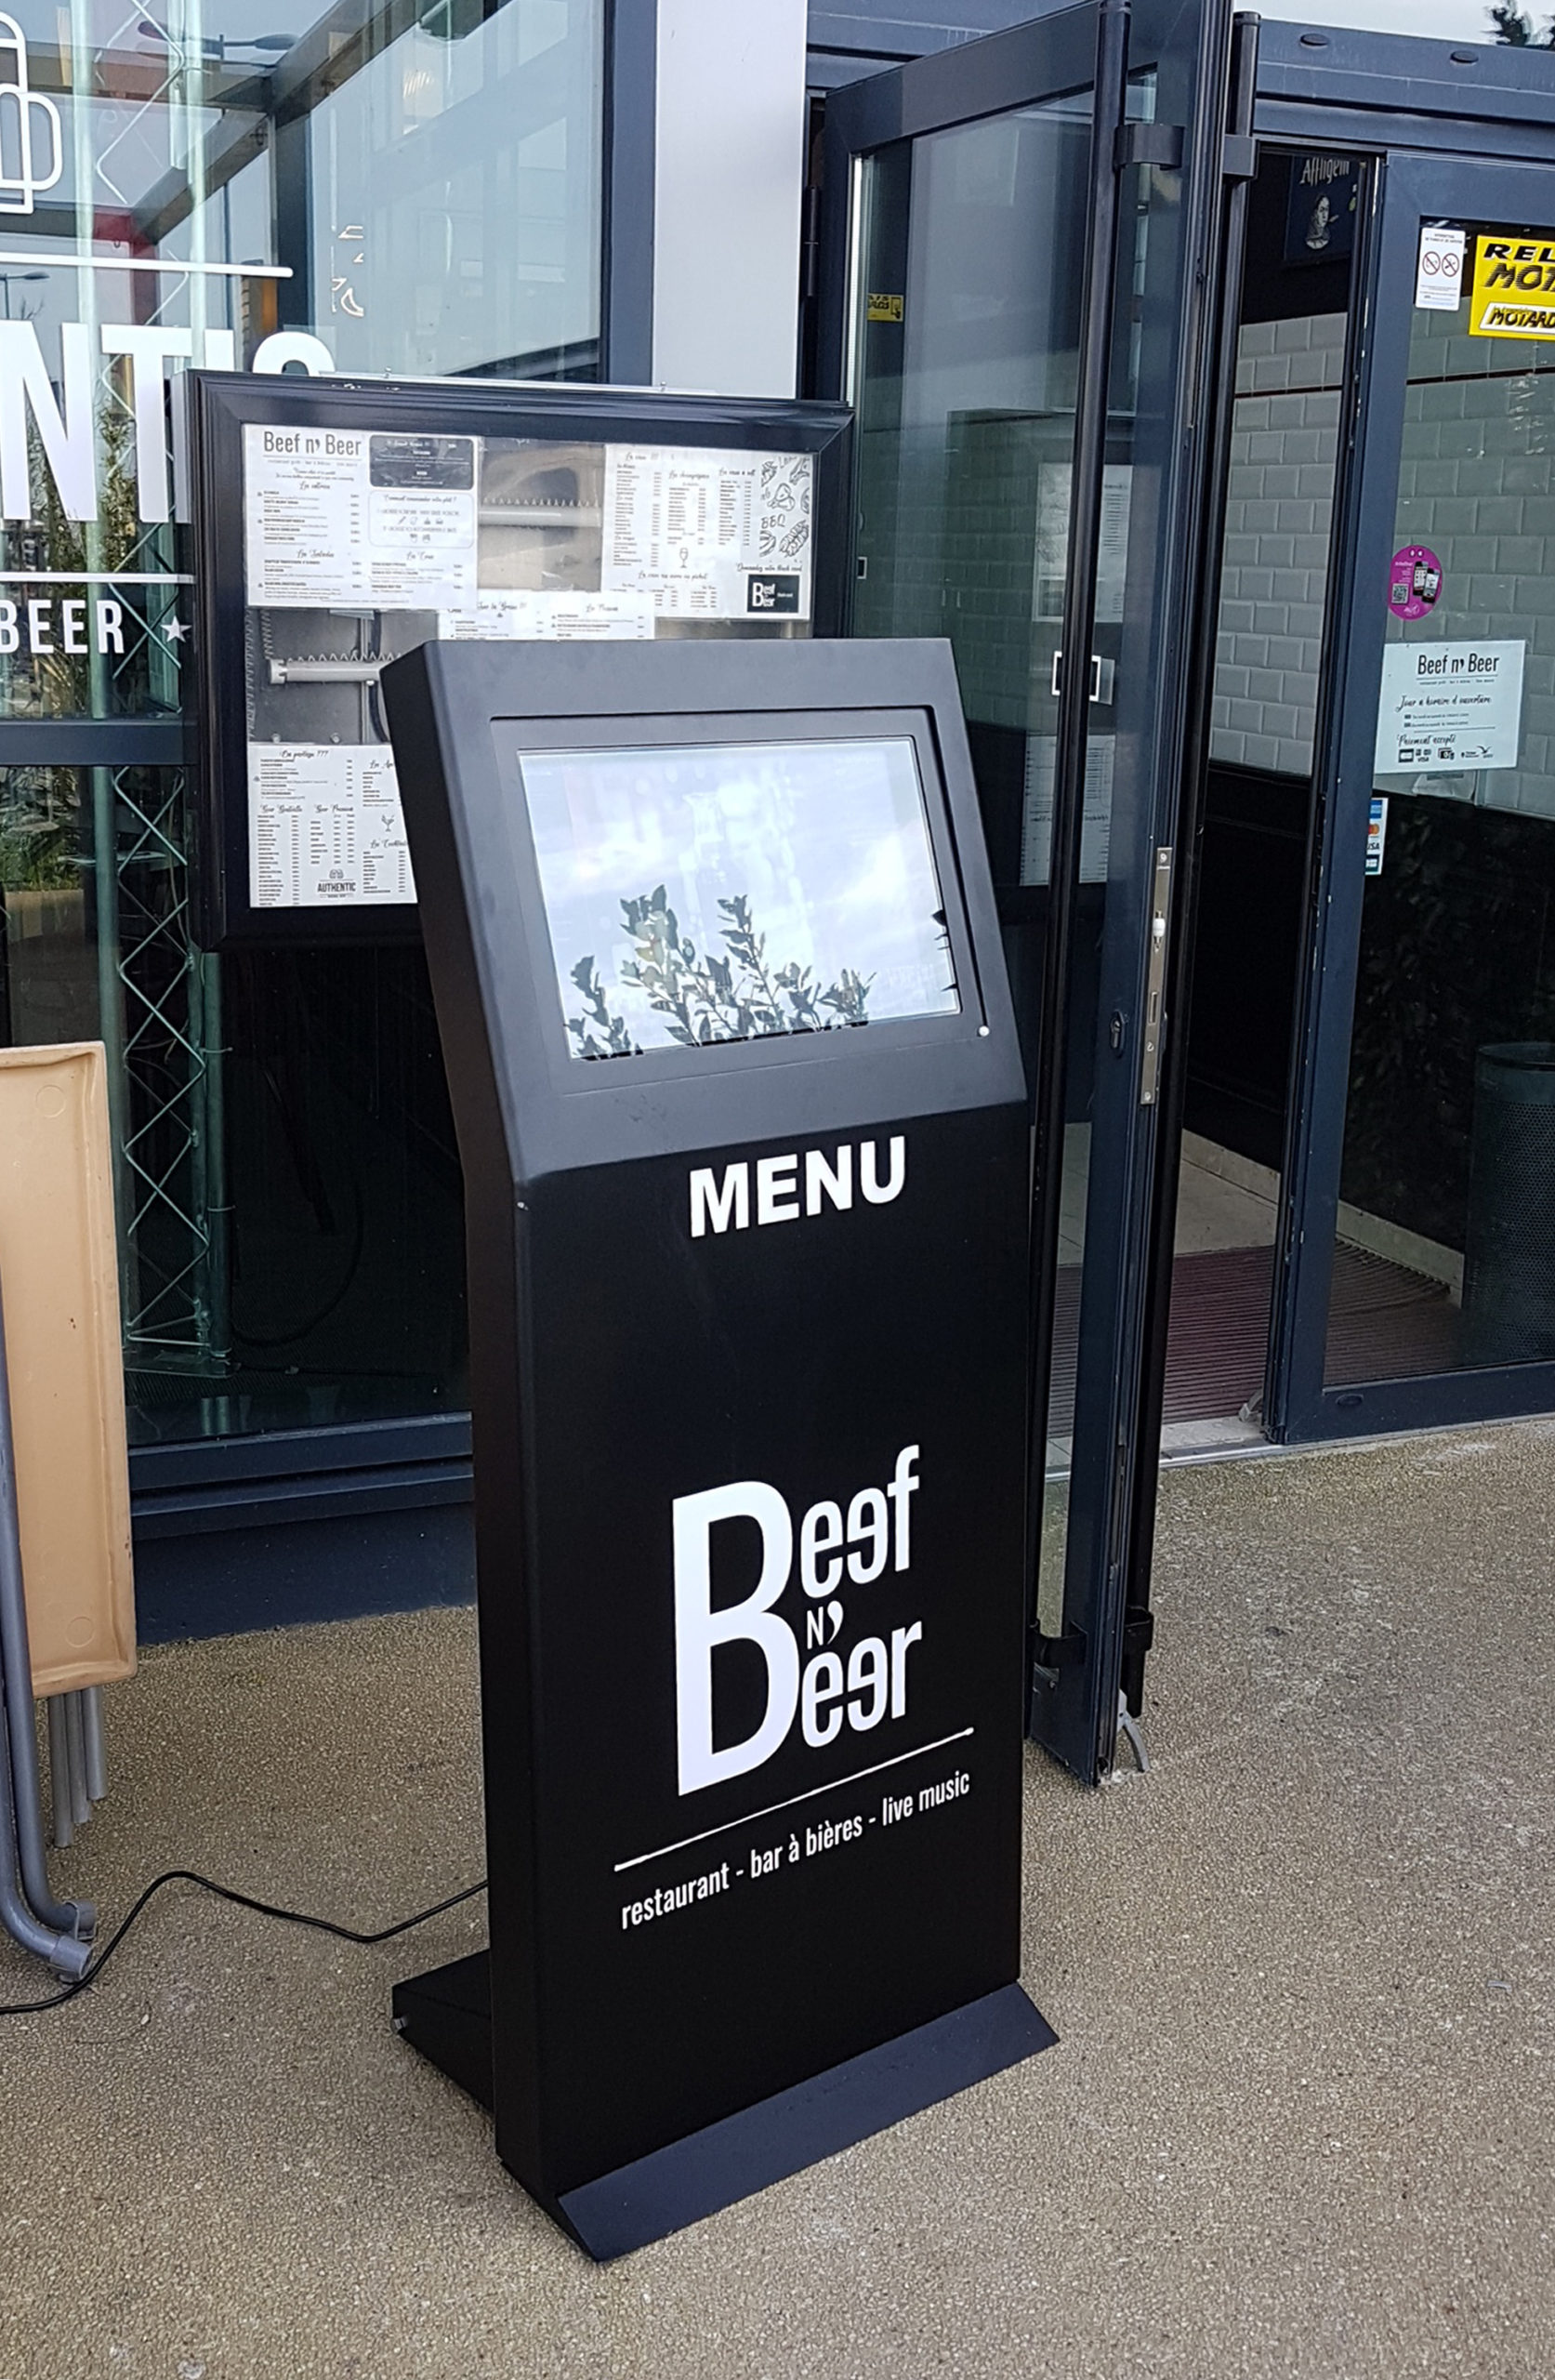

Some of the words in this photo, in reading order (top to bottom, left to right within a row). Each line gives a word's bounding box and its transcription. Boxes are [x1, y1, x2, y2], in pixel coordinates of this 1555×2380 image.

[1299, 156, 1350, 186] Affligem
[264, 431, 300, 454] Beef
[325, 433, 362, 456] Beer
[0, 599, 125, 654] BEER
[1417, 654, 1448, 675] Beef
[1468, 653, 1500, 673] Beer
[317, 882, 356, 892] AUTHENTIC
[690, 1135, 906, 1238] MENU
[621, 1862, 730, 1930] restaurant
[750, 1845, 783, 1879] bar
[788, 1833, 800, 1863] à
[806, 1813, 863, 1858] bières
[882, 1795, 914, 1827] live
[918, 1770, 970, 1812] music
